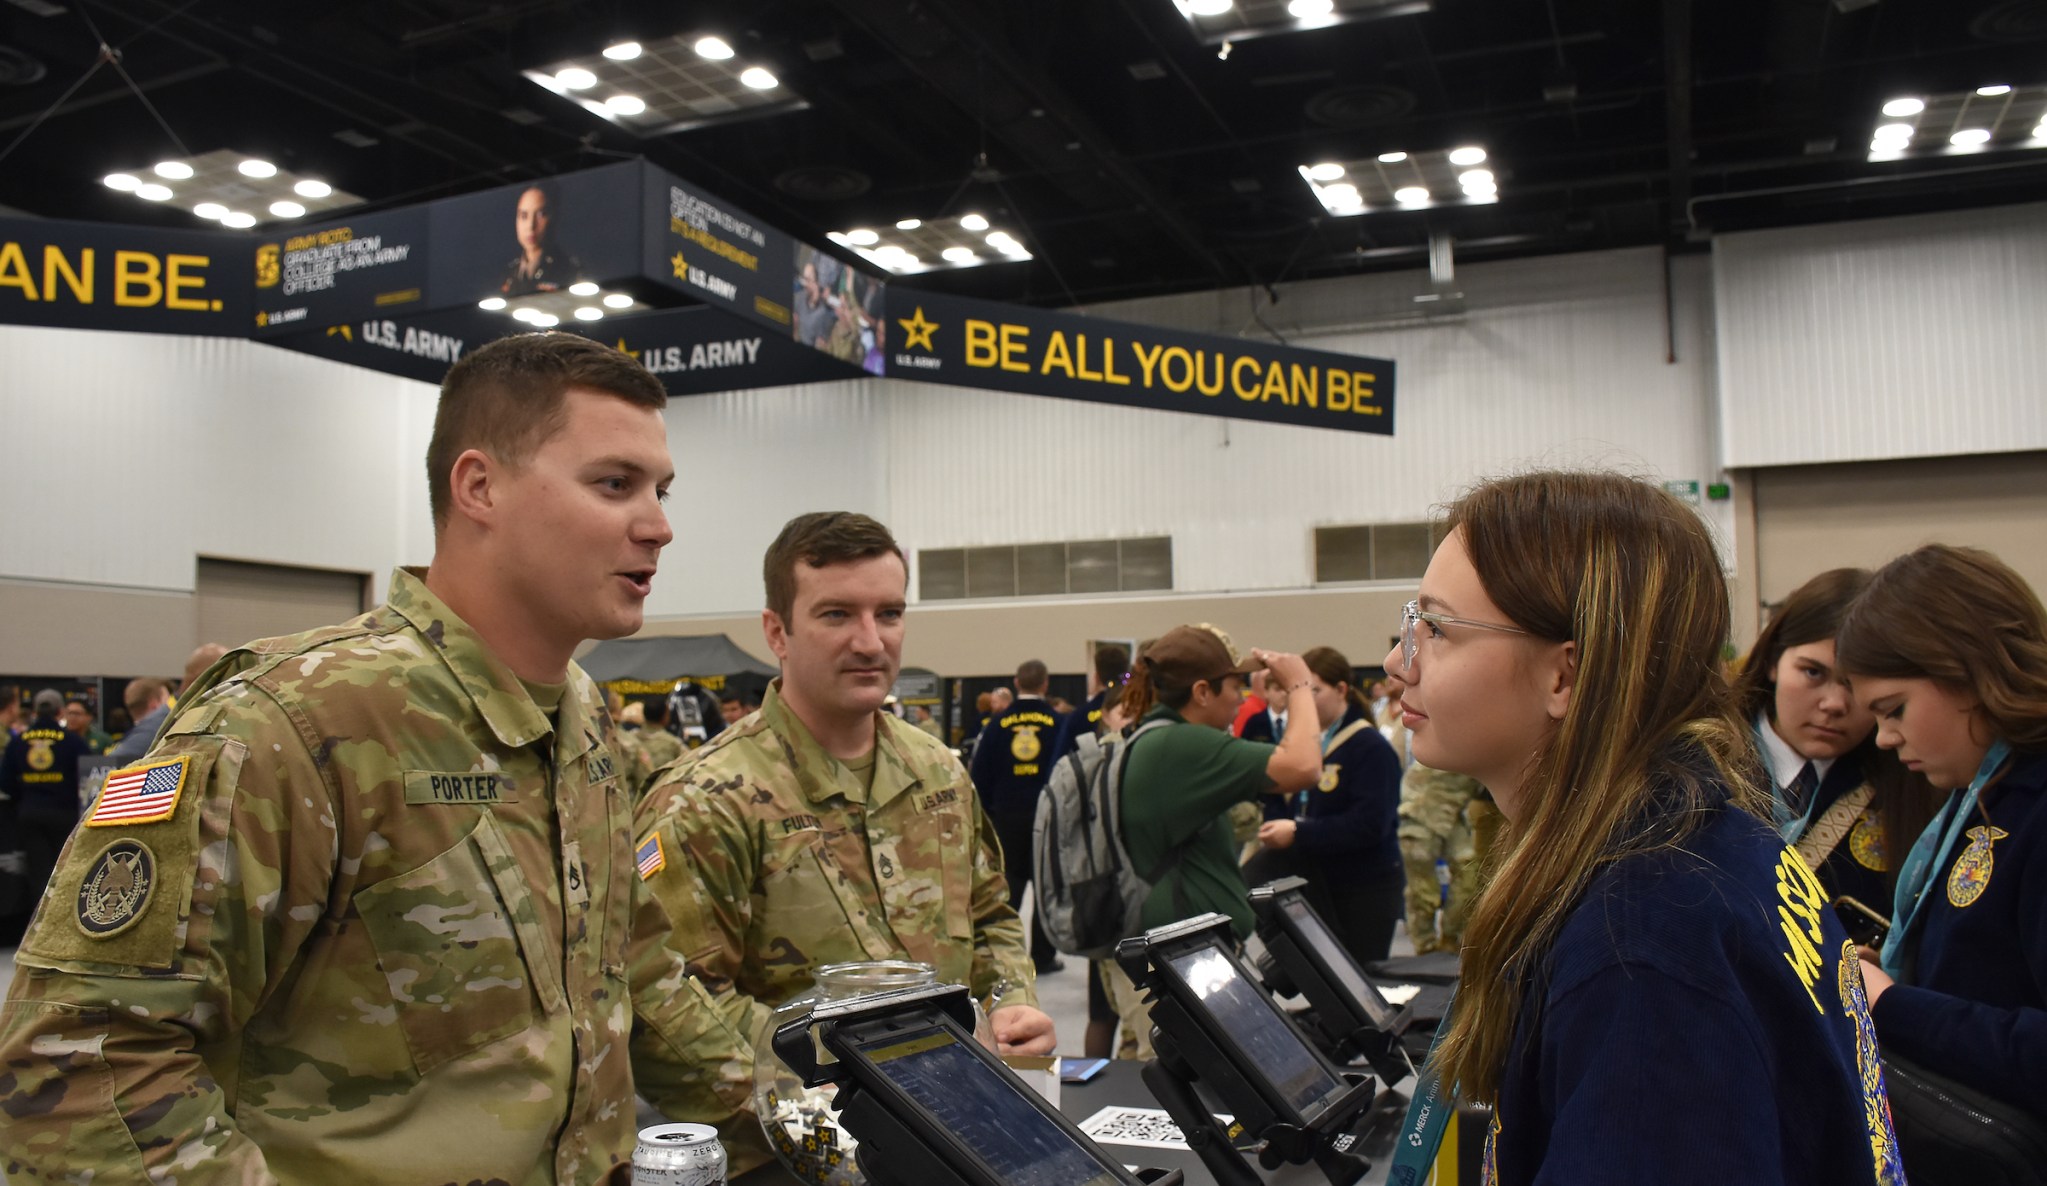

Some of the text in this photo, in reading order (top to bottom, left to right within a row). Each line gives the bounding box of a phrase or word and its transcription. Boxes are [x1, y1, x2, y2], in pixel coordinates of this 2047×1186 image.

[115, 250, 223, 312] BE.
[363, 322, 463, 362] U.S. ARMY
[645, 338, 761, 373] U.S. ARMY
[965, 319, 1382, 415] BE ALL YOU CAN BE.
[1000, 711, 1055, 728] OKLAHOMA
[430, 775, 498, 800] PORTER
[1415, 1103, 1431, 1133] MERCK
[692, 1144, 718, 1157] ZERO
